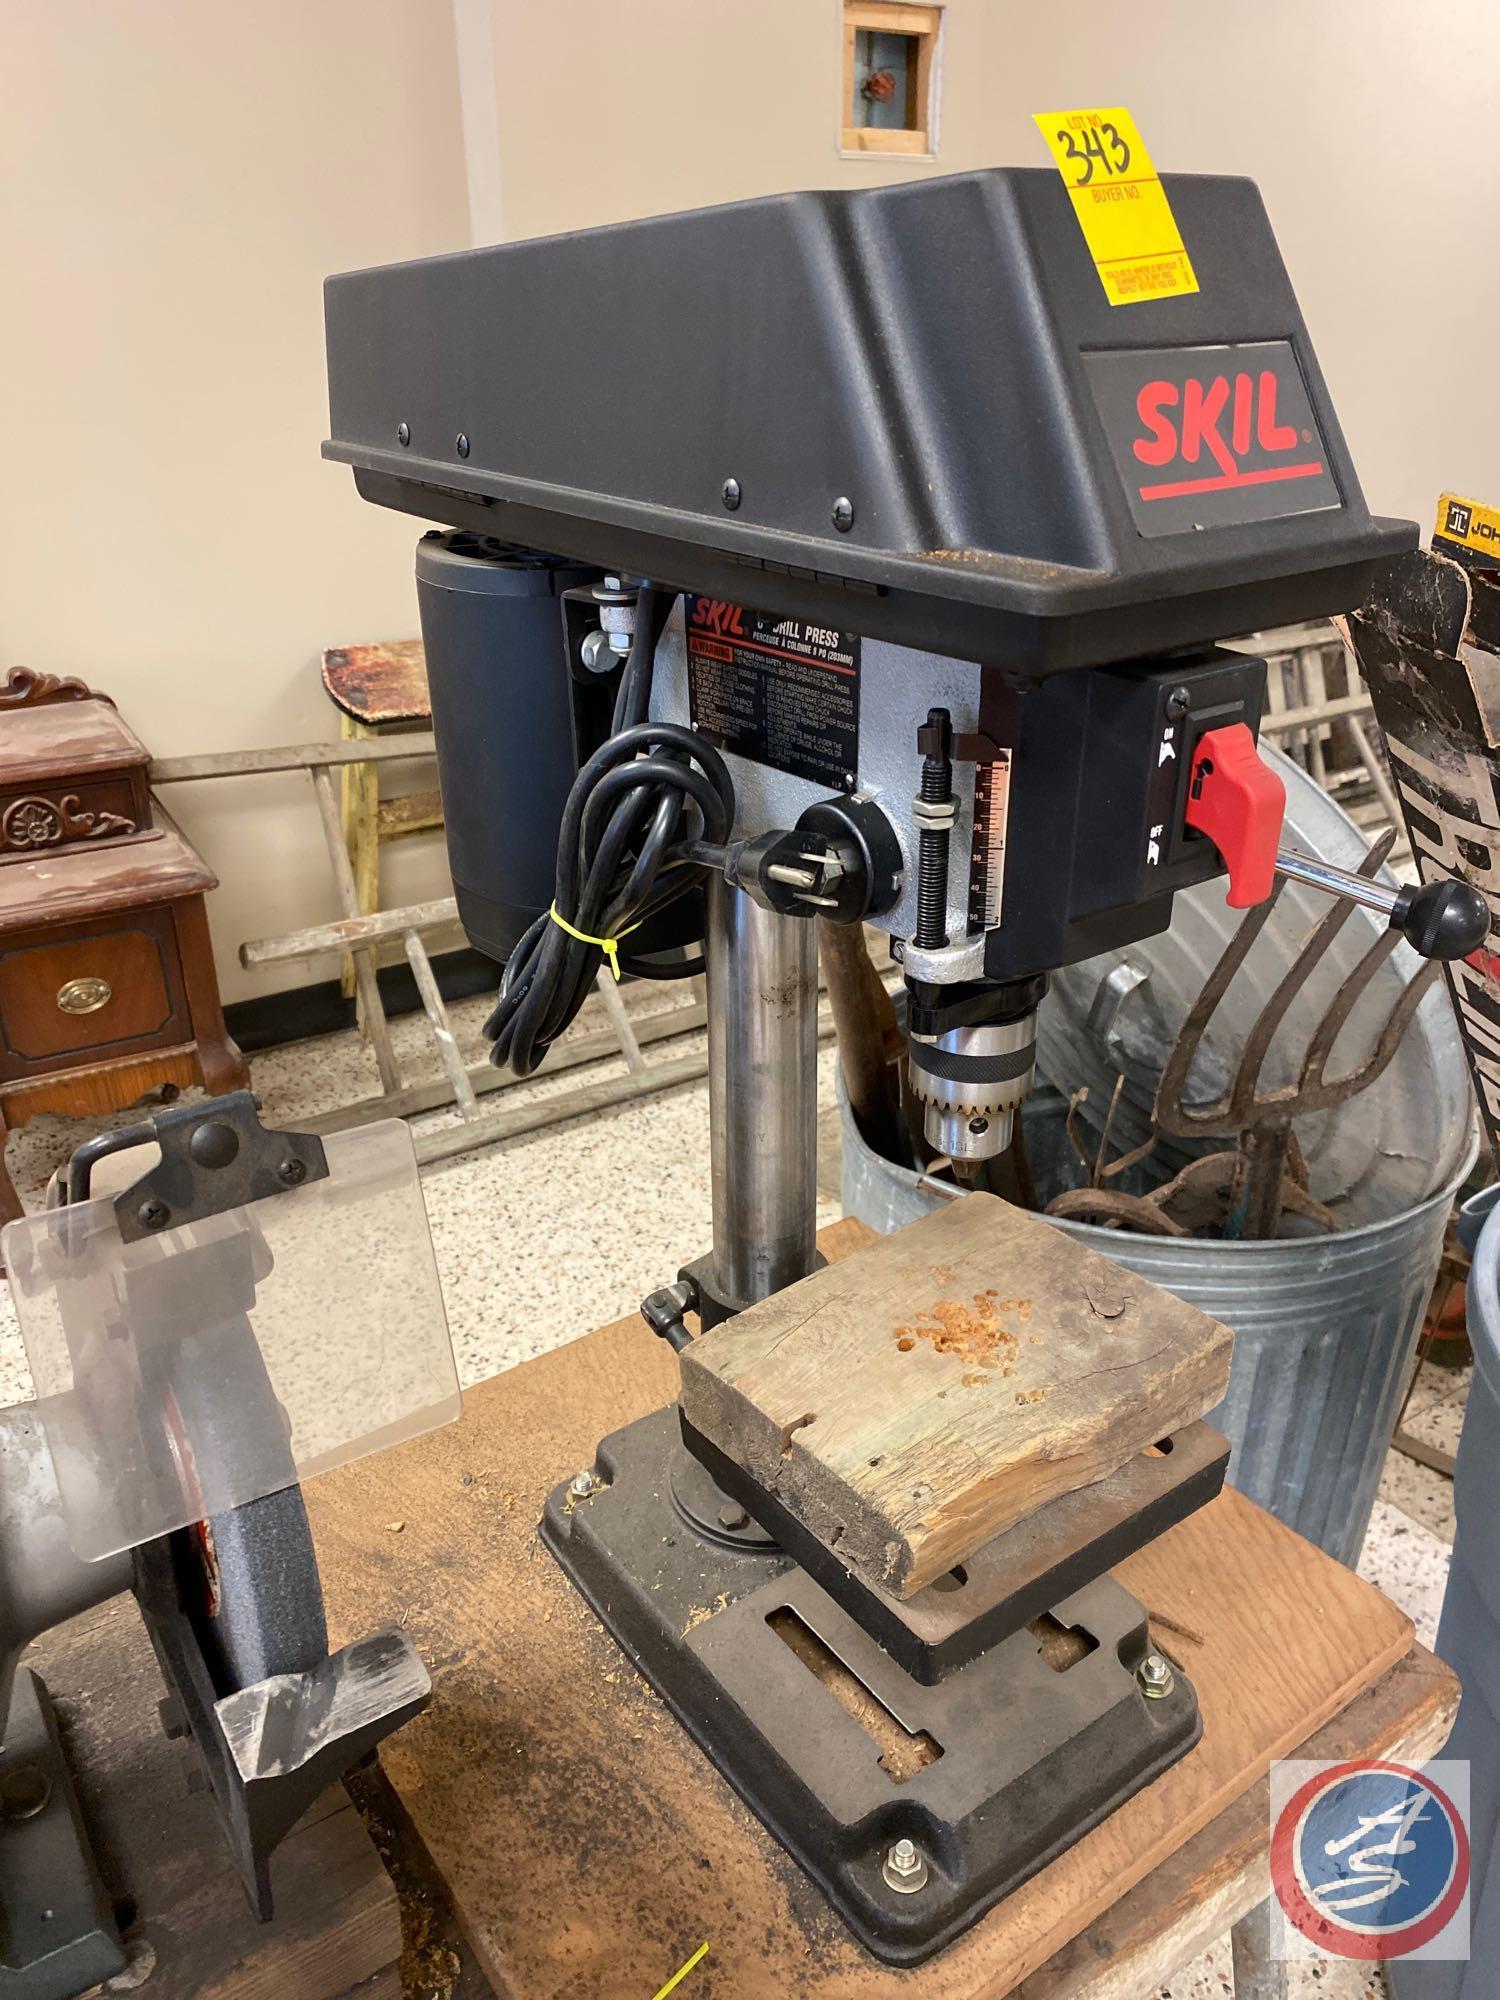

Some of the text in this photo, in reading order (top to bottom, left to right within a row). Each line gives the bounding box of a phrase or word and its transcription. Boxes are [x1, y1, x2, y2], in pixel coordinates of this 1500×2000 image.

[1066, 116, 1086, 130] LOT
[1057, 123, 1130, 186] 343
[1092, 186, 1143, 203] BUYER NO.
[1133, 370, 1298, 476] SKIL
[692, 597, 744, 636] SKIL
[753, 630, 778, 646] PERCEUSE
[787, 639, 811, 655] COLONNE
[805, 624, 838, 649] PRESS
[1164, 727, 1174, 740] ON
[975, 792, 984, 800] 10
[973, 823, 982, 831] 20
[1150, 824, 1163, 838] OFF
[972, 854, 982, 862] 30
[970, 884, 980, 892] 40
[969, 913, 978, 921] 50
